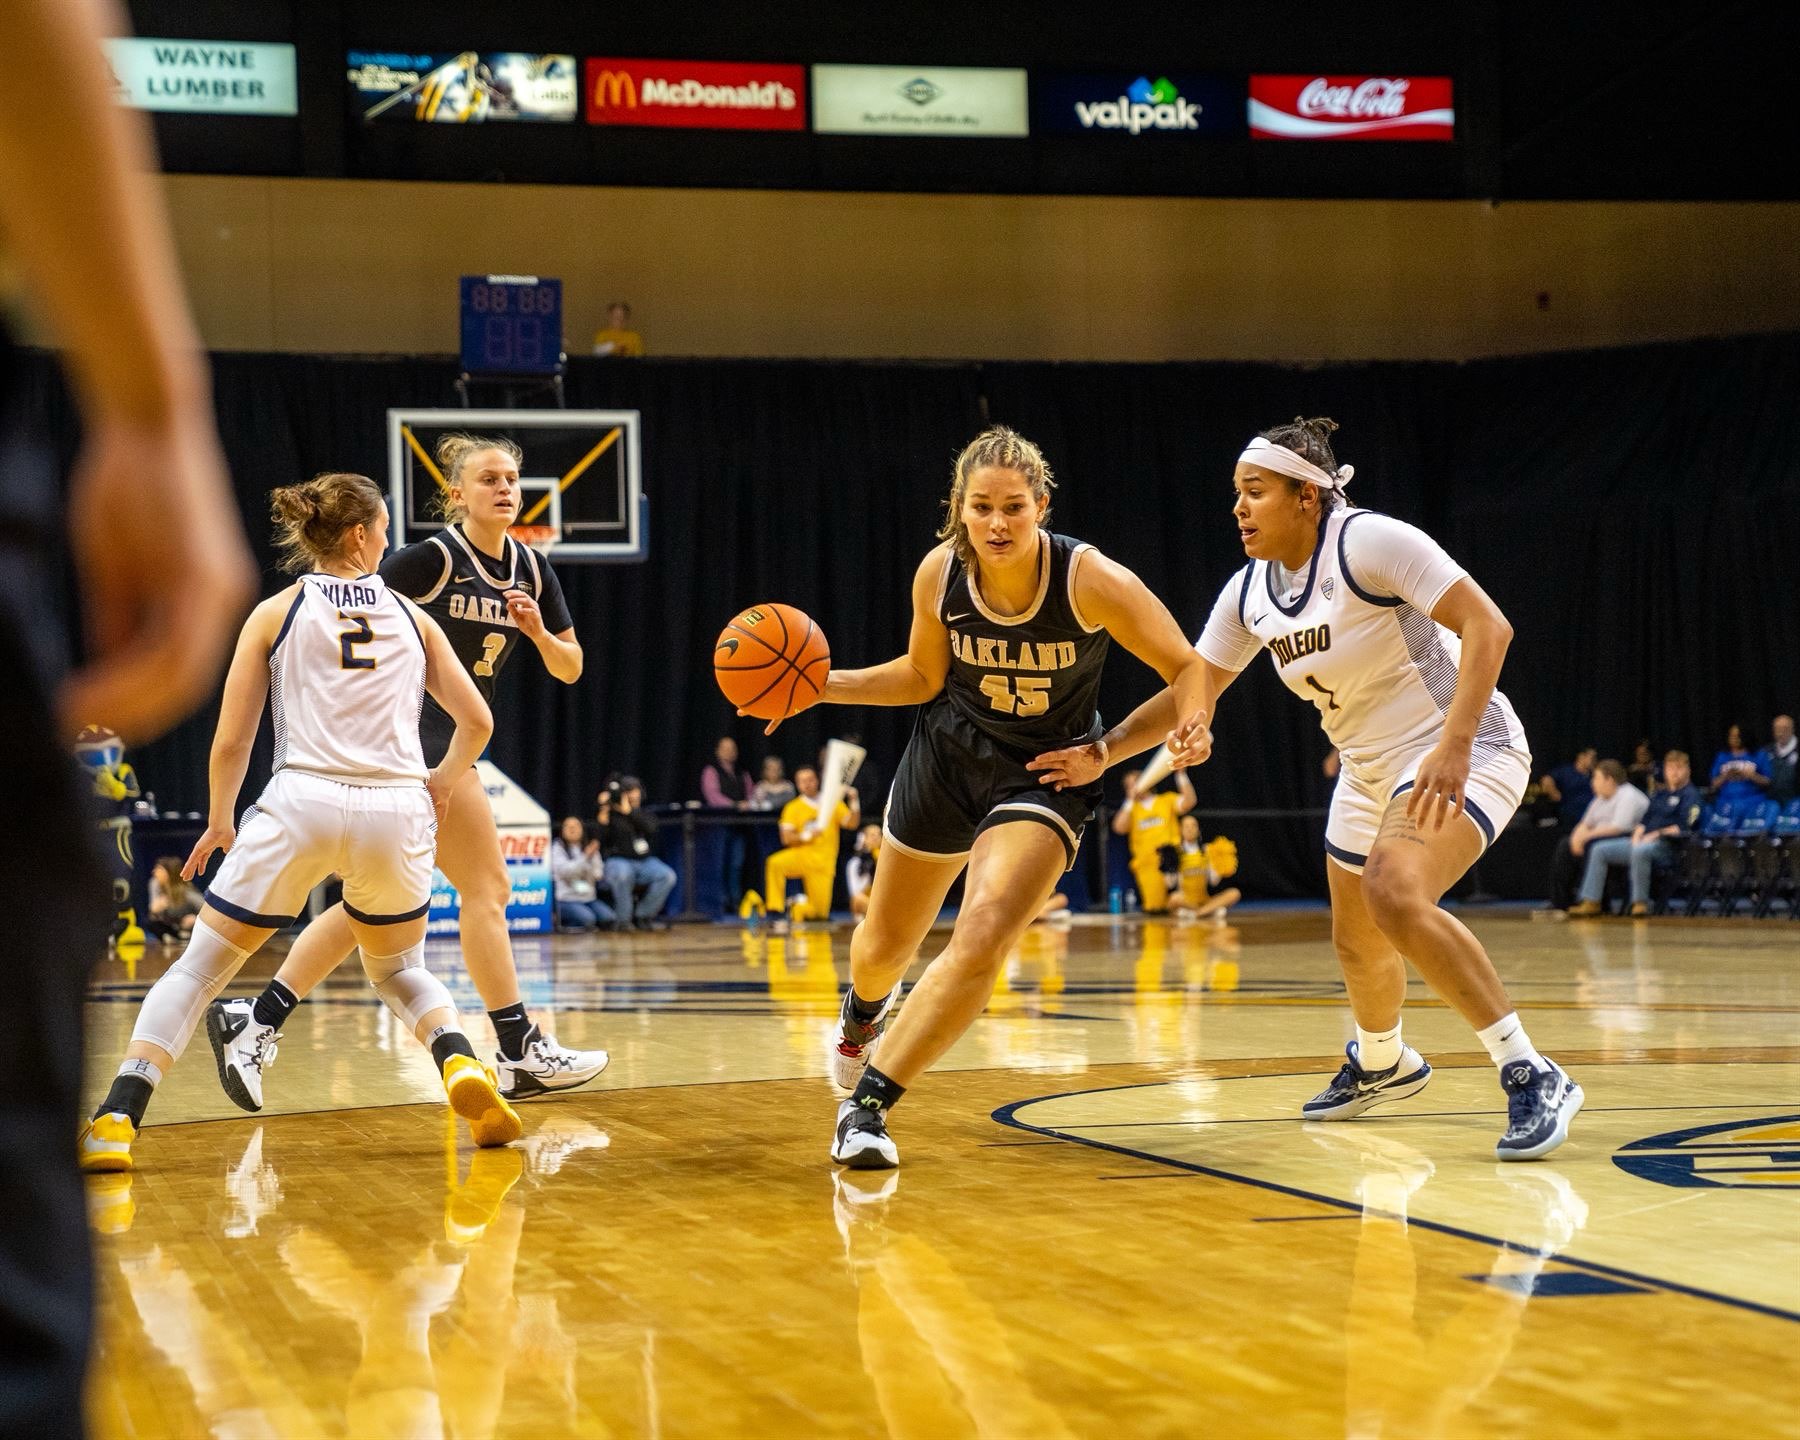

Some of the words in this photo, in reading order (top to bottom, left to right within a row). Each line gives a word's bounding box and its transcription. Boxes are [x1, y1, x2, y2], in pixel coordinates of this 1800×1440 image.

[154, 45, 255, 69] WAYNE
[147, 77, 265, 97] LUMBER
[642, 78, 795, 110] McDonald's
[1075, 96, 1200, 134] valpak
[448, 593, 520, 629] OAKL
[338, 609, 376, 670] 2
[473, 632, 507, 677] 3
[1267, 623, 1332, 669] TOLEDO
[979, 674, 1052, 718] 45
